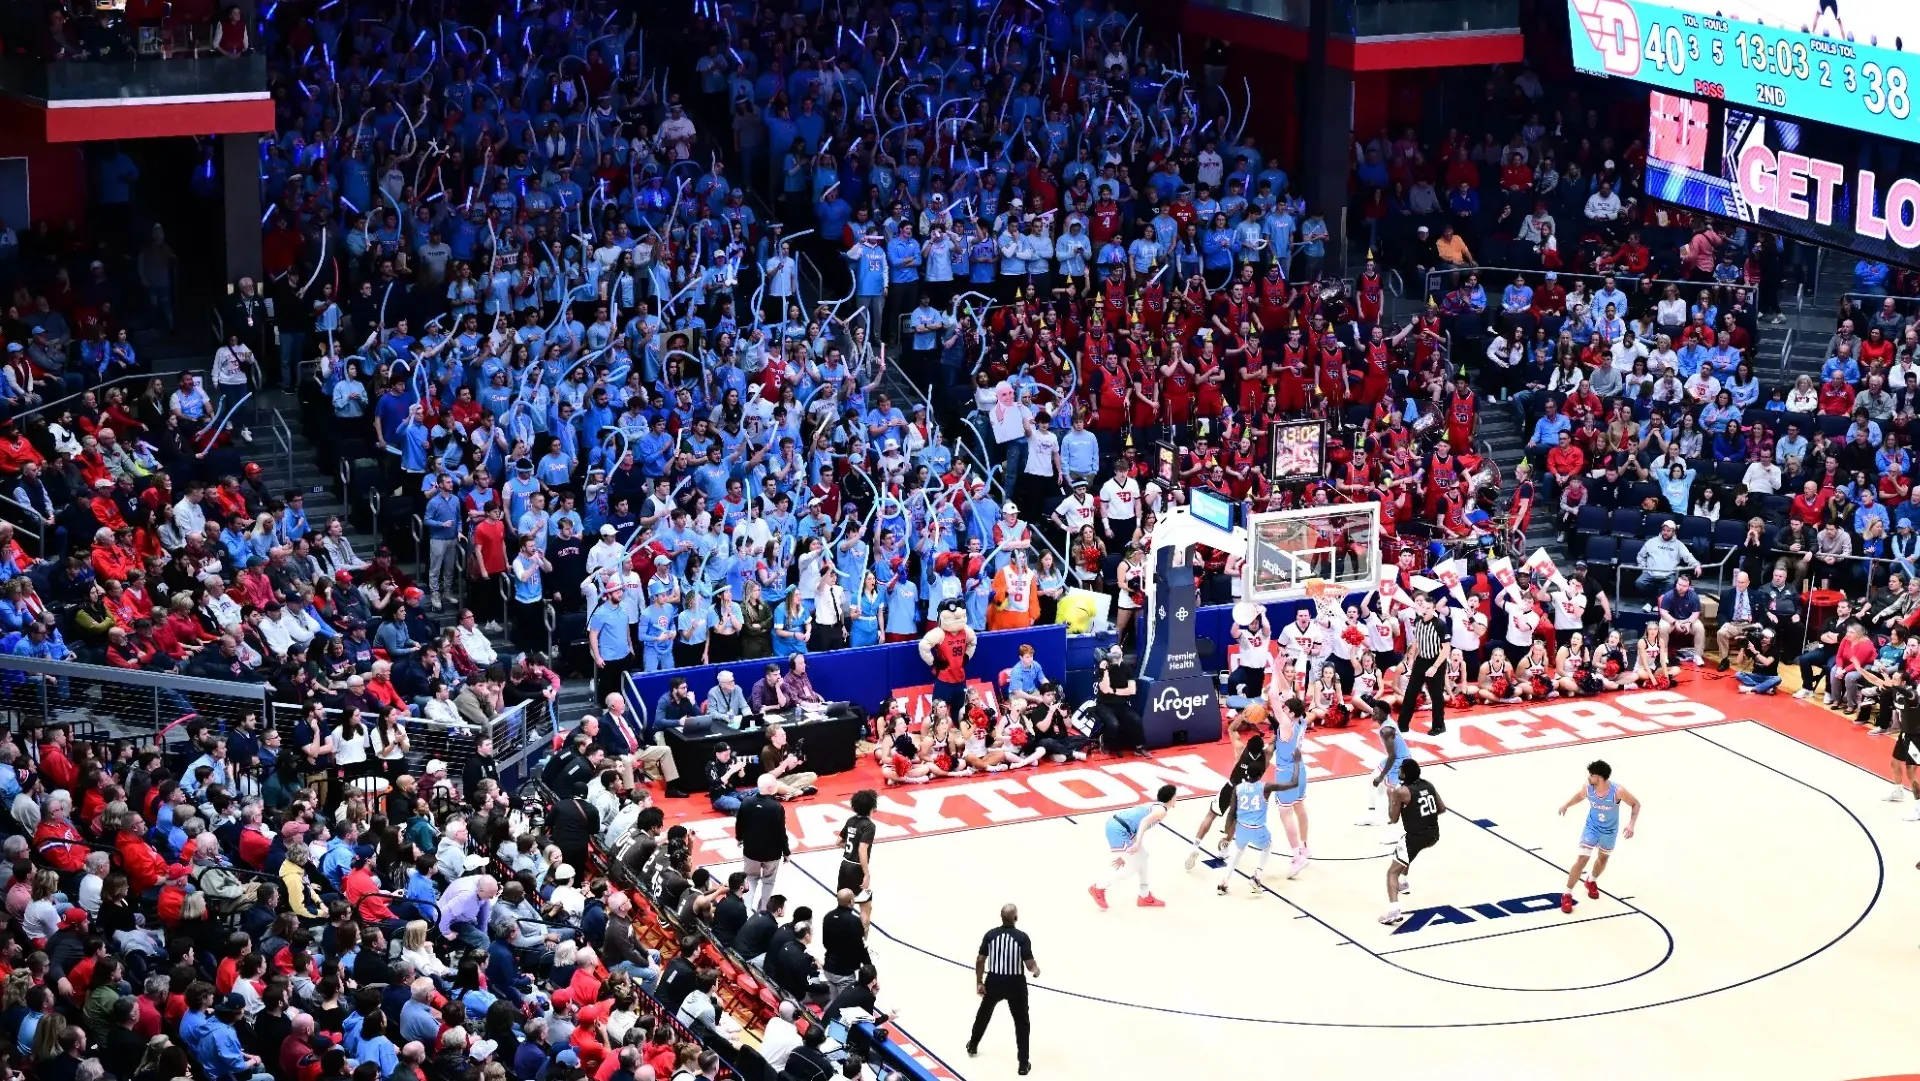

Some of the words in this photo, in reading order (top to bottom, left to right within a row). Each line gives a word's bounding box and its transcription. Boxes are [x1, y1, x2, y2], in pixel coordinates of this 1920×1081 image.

[1683, 14, 1699, 28] TOL
[1703, 17, 1729, 33] FOULS
[1644, 22, 1685, 75] 40
[1688, 34, 1700, 60] 3
[1712, 38, 1725, 66] 5
[1735, 31, 1810, 81] 13:03
[1810, 39, 1837, 56] FOULS
[1839, 45, 1856, 59] TOL
[1694, 79, 1725, 100] POSS
[1756, 83, 1786, 108] 2ND
[1819, 60, 1832, 88] 2
[1844, 64, 1857, 93] 3
[1861, 61, 1911, 120] 38
[1738, 145, 1844, 226] GET
[1855, 170, 1920, 249] LO
[774, 376, 782, 388] 2
[952, 646, 964, 657] 99
[1167, 651, 1197, 663] Premier
[1168, 660, 1194, 670] Health
[1153, 686, 1210, 720] Kroger
[1239, 795, 1260, 811] 24
[1418, 795, 1437, 817] 20
[1597, 813, 1606, 822] 2
[845, 833, 855, 853] 5
[1390, 892, 1579, 936] A10
